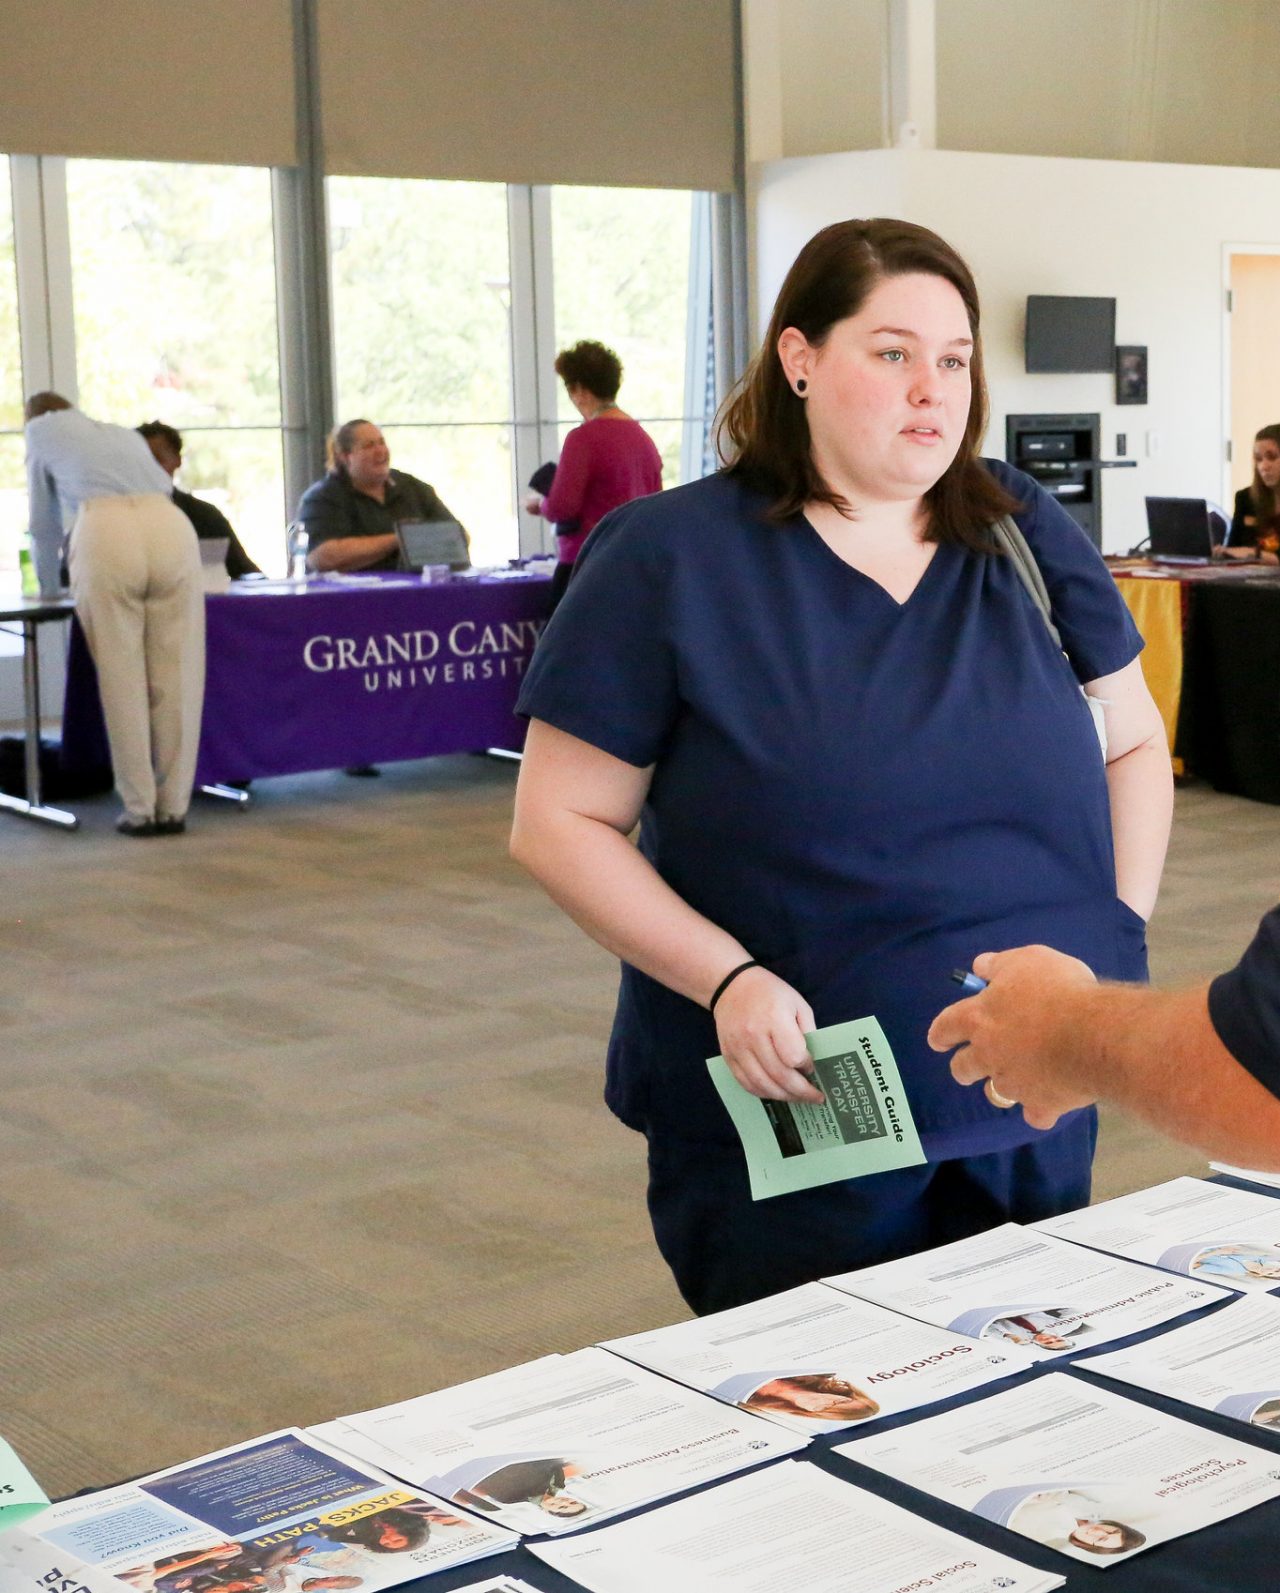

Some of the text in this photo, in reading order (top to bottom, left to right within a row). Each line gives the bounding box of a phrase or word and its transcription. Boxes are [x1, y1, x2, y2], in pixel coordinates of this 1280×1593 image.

[303, 621, 545, 672] GRAND CANY
[364, 656, 525, 692] UNIVERSIT
[831, 1086, 850, 1114] DAY
[833, 1062, 868, 1135] TRANSFER
[843, 1056, 881, 1136] UNIVERSITY
[858, 1036, 904, 1143] Student Guide
[1133, 1282, 1173, 1298] Public
[1045, 1298, 1136, 1329] Administration
[867, 1344, 973, 1385] Sociology
[681, 1429, 738, 1449] Business
[581, 1449, 680, 1479] Administration
[1155, 1459, 1246, 1497] Psychological
[1160, 1459, 1222, 1482] Sciences
[333, 1484, 364, 1495] What
[256, 1509, 289, 1521] Path?
[288, 1498, 320, 1510] Jacks
[327, 1493, 402, 1521] JACKS
[167, 1525, 189, 1536] Did
[255, 1522, 318, 1547] PATH
[101, 1542, 140, 1558] Know?
[932, 1560, 977, 1582] Social
